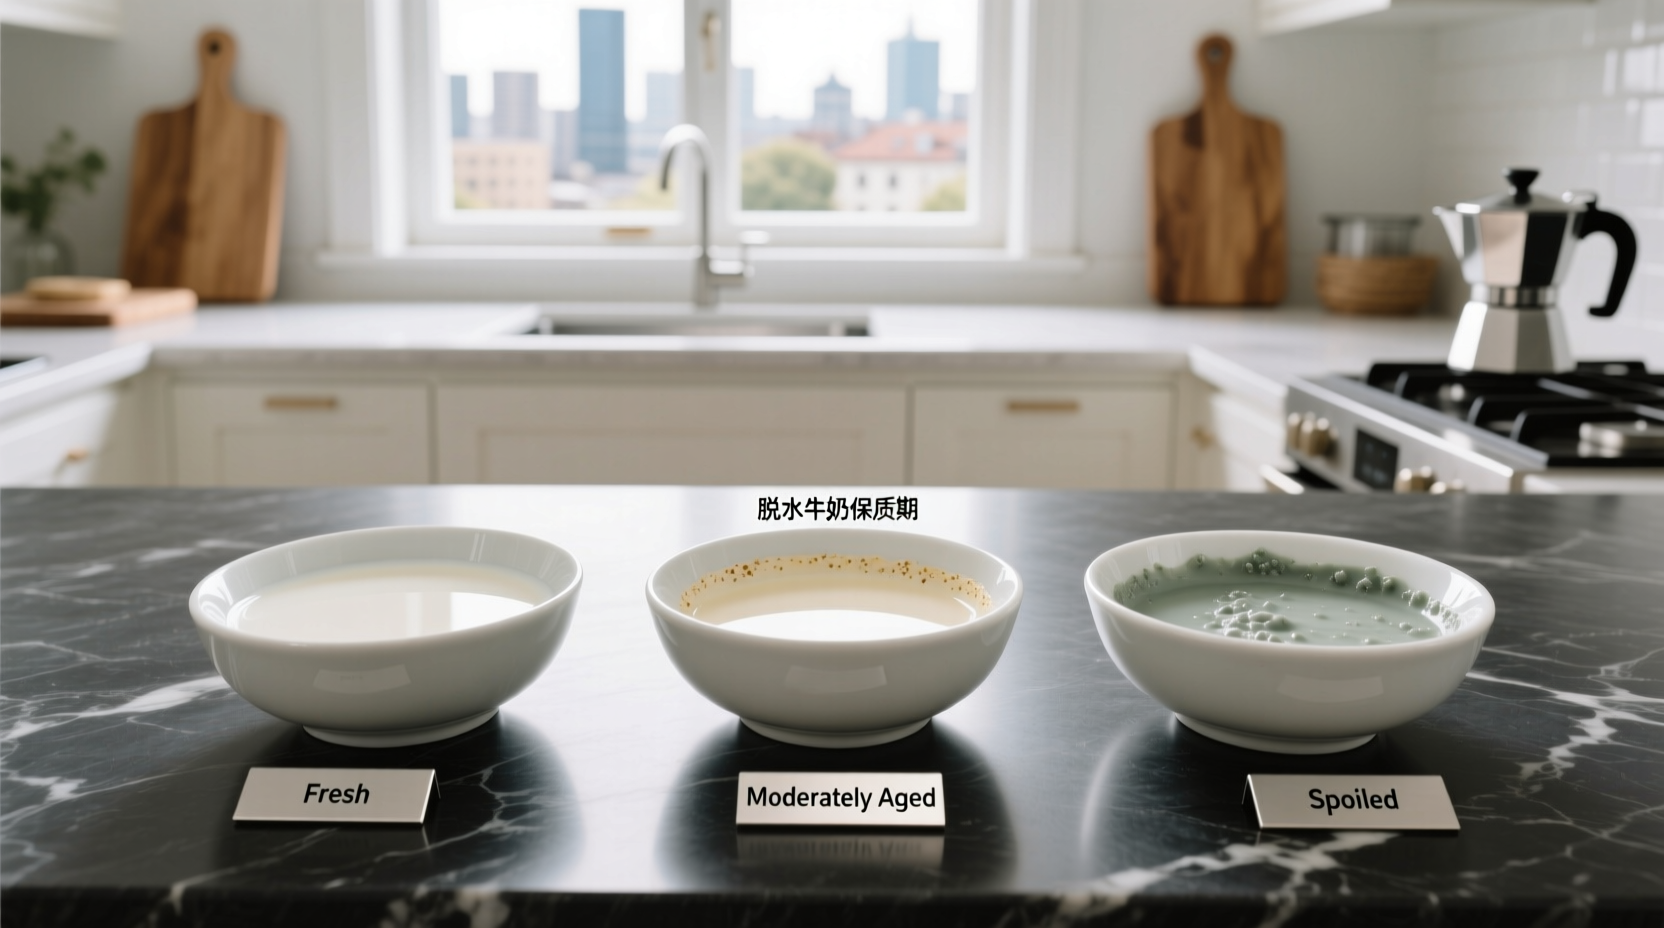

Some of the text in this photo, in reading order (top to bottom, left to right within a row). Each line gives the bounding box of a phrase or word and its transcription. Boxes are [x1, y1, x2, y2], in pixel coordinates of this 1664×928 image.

[303, 783, 370, 805] Fresh
[747, 786, 936, 812] Moderately Aged
[1308, 788, 1400, 816] Spoiled
